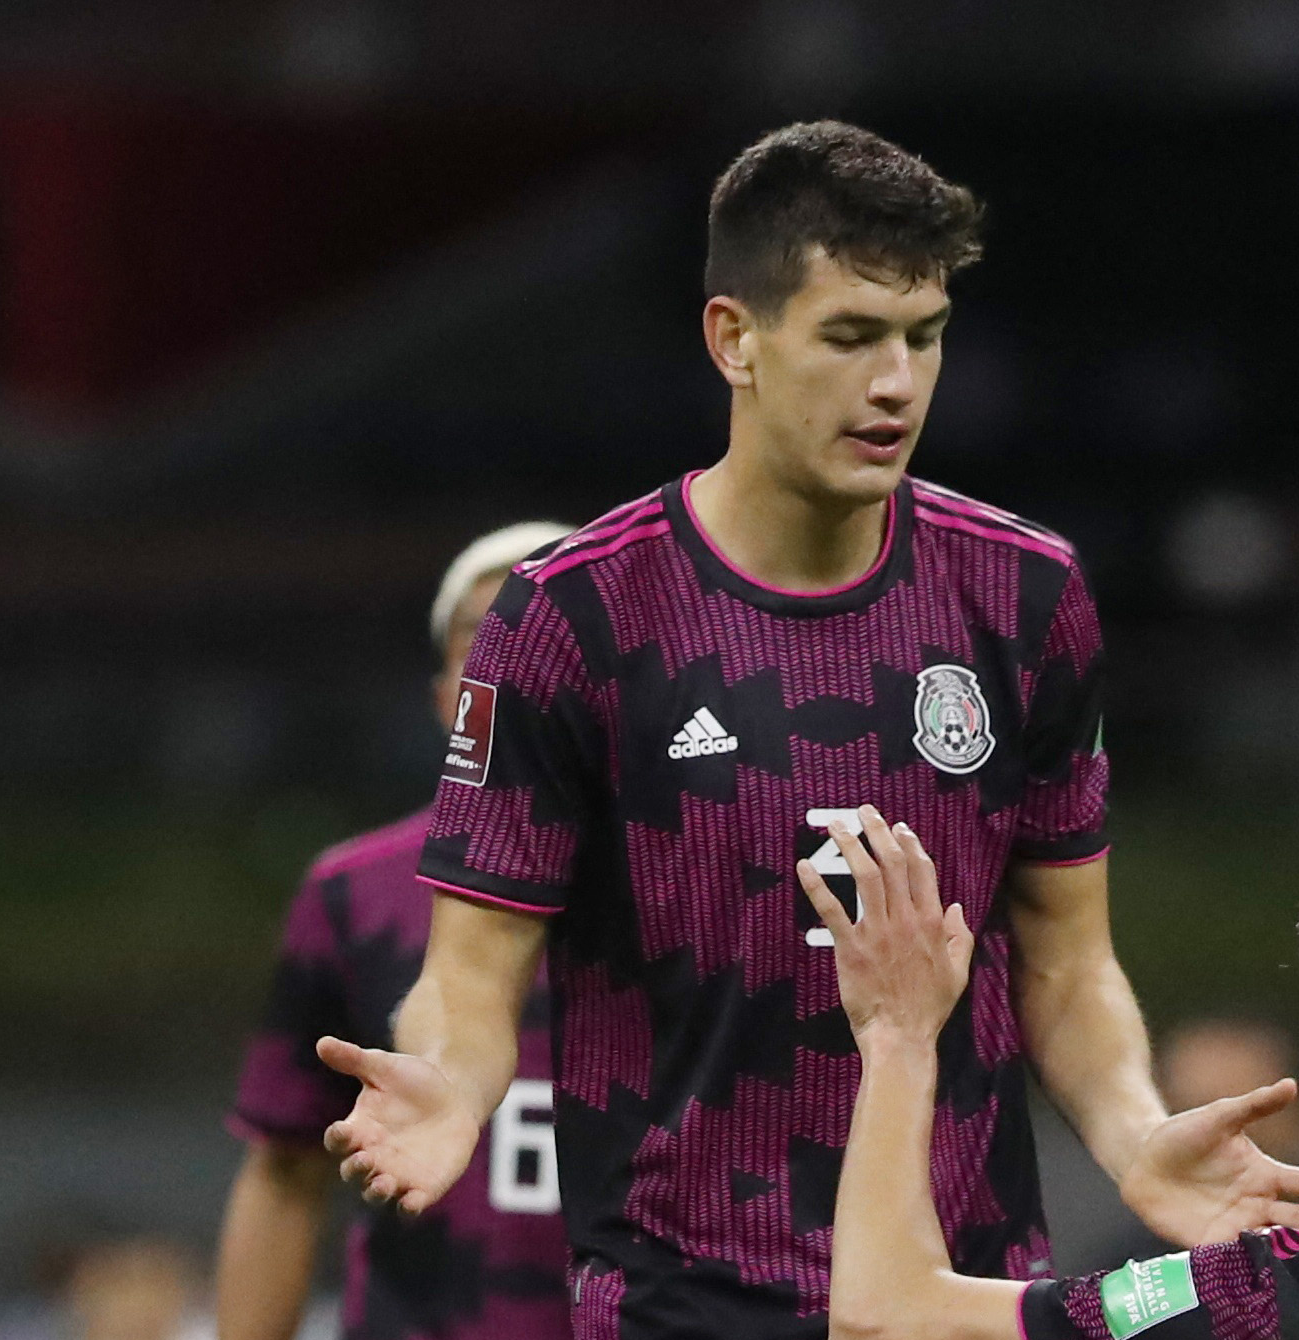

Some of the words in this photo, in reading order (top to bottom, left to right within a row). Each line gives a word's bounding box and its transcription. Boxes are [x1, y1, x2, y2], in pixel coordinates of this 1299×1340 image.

[668, 736, 739, 760] adidas
[489, 1079, 563, 1214] 6
[1150, 1262, 1170, 1312] IVING
[1123, 1292, 1143, 1326] FIFA
